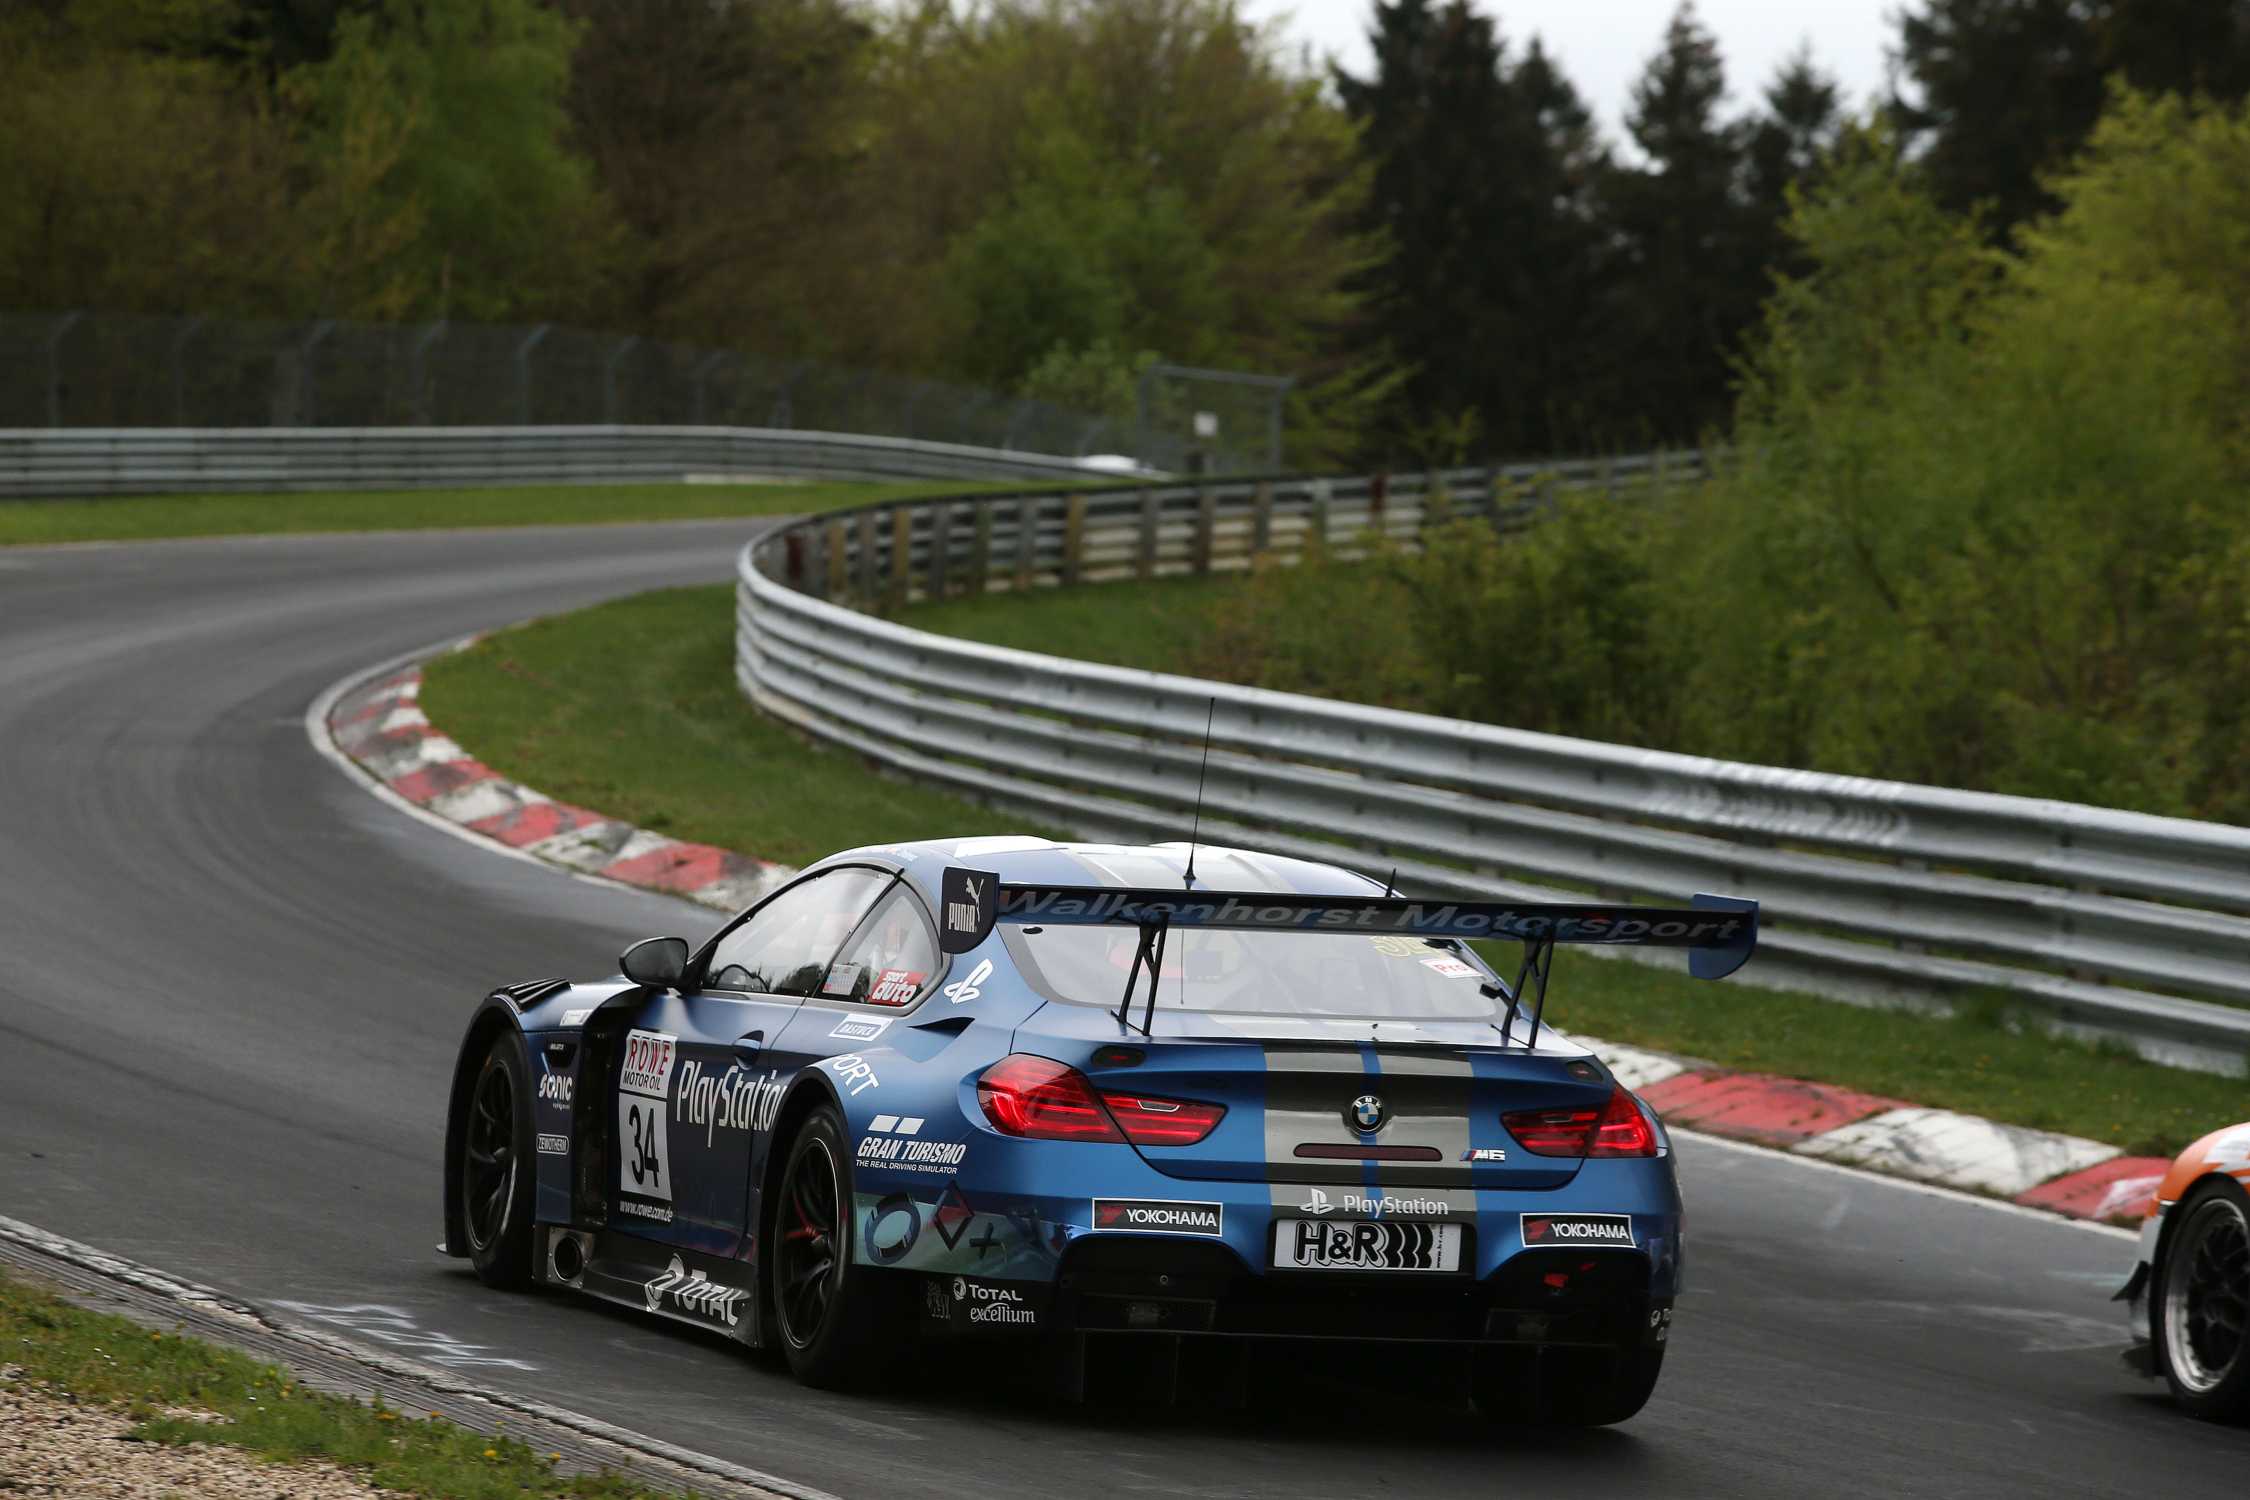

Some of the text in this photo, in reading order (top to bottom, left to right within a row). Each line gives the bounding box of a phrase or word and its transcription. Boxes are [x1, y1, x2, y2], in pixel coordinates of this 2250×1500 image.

[948, 902, 976, 933] PUMA
[1003, 889, 1741, 939] Walkenhorst Motorsport
[872, 981, 917, 1003] auto
[626, 1035, 671, 1076] ROWE
[622, 1071, 661, 1091] MOTOR OIL
[628, 1104, 660, 1188] 34
[857, 1136, 967, 1165] GRAN TURISMO
[1472, 1149, 1506, 1162] M6
[856, 1159, 958, 1175] THE REAL DRIVING SIMULATOR
[1343, 1195, 1449, 1218] PlayStation
[1126, 1208, 1217, 1228] YOKOHAMA
[1551, 1223, 1630, 1240] YOKOHAMA
[1294, 1221, 1387, 1268] H&R
[674, 1269, 744, 1326] TOTAL
[969, 1284, 1023, 1302] TOTAL
[970, 1302, 1036, 1323] excellium
